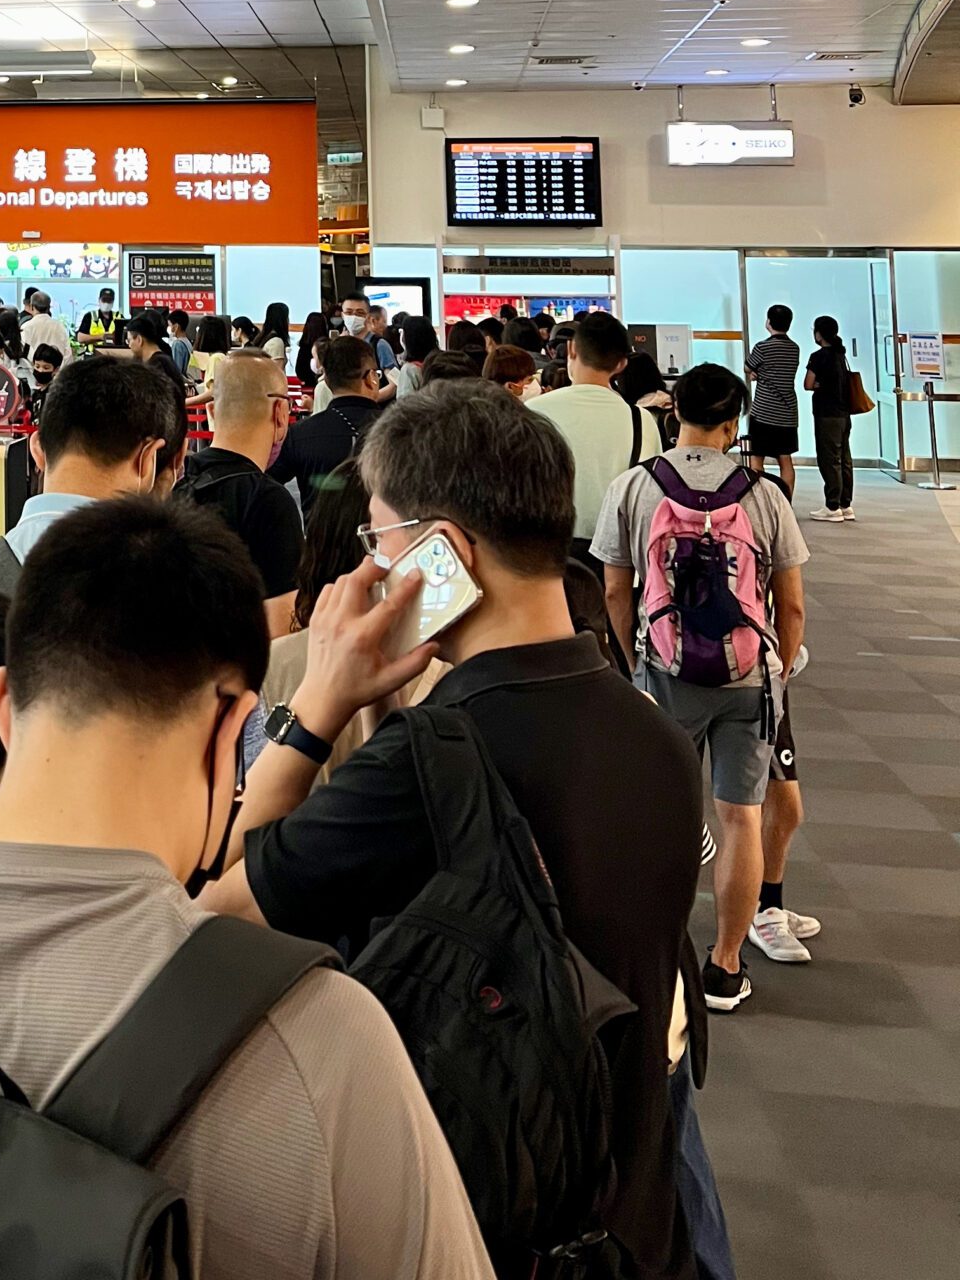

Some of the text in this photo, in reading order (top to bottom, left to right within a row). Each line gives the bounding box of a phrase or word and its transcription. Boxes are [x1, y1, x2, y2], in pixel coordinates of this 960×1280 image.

[745, 139, 787, 148] SEIKO
[175, 153, 271, 174] 国際線出発
[39, 188, 149, 209] Departures
